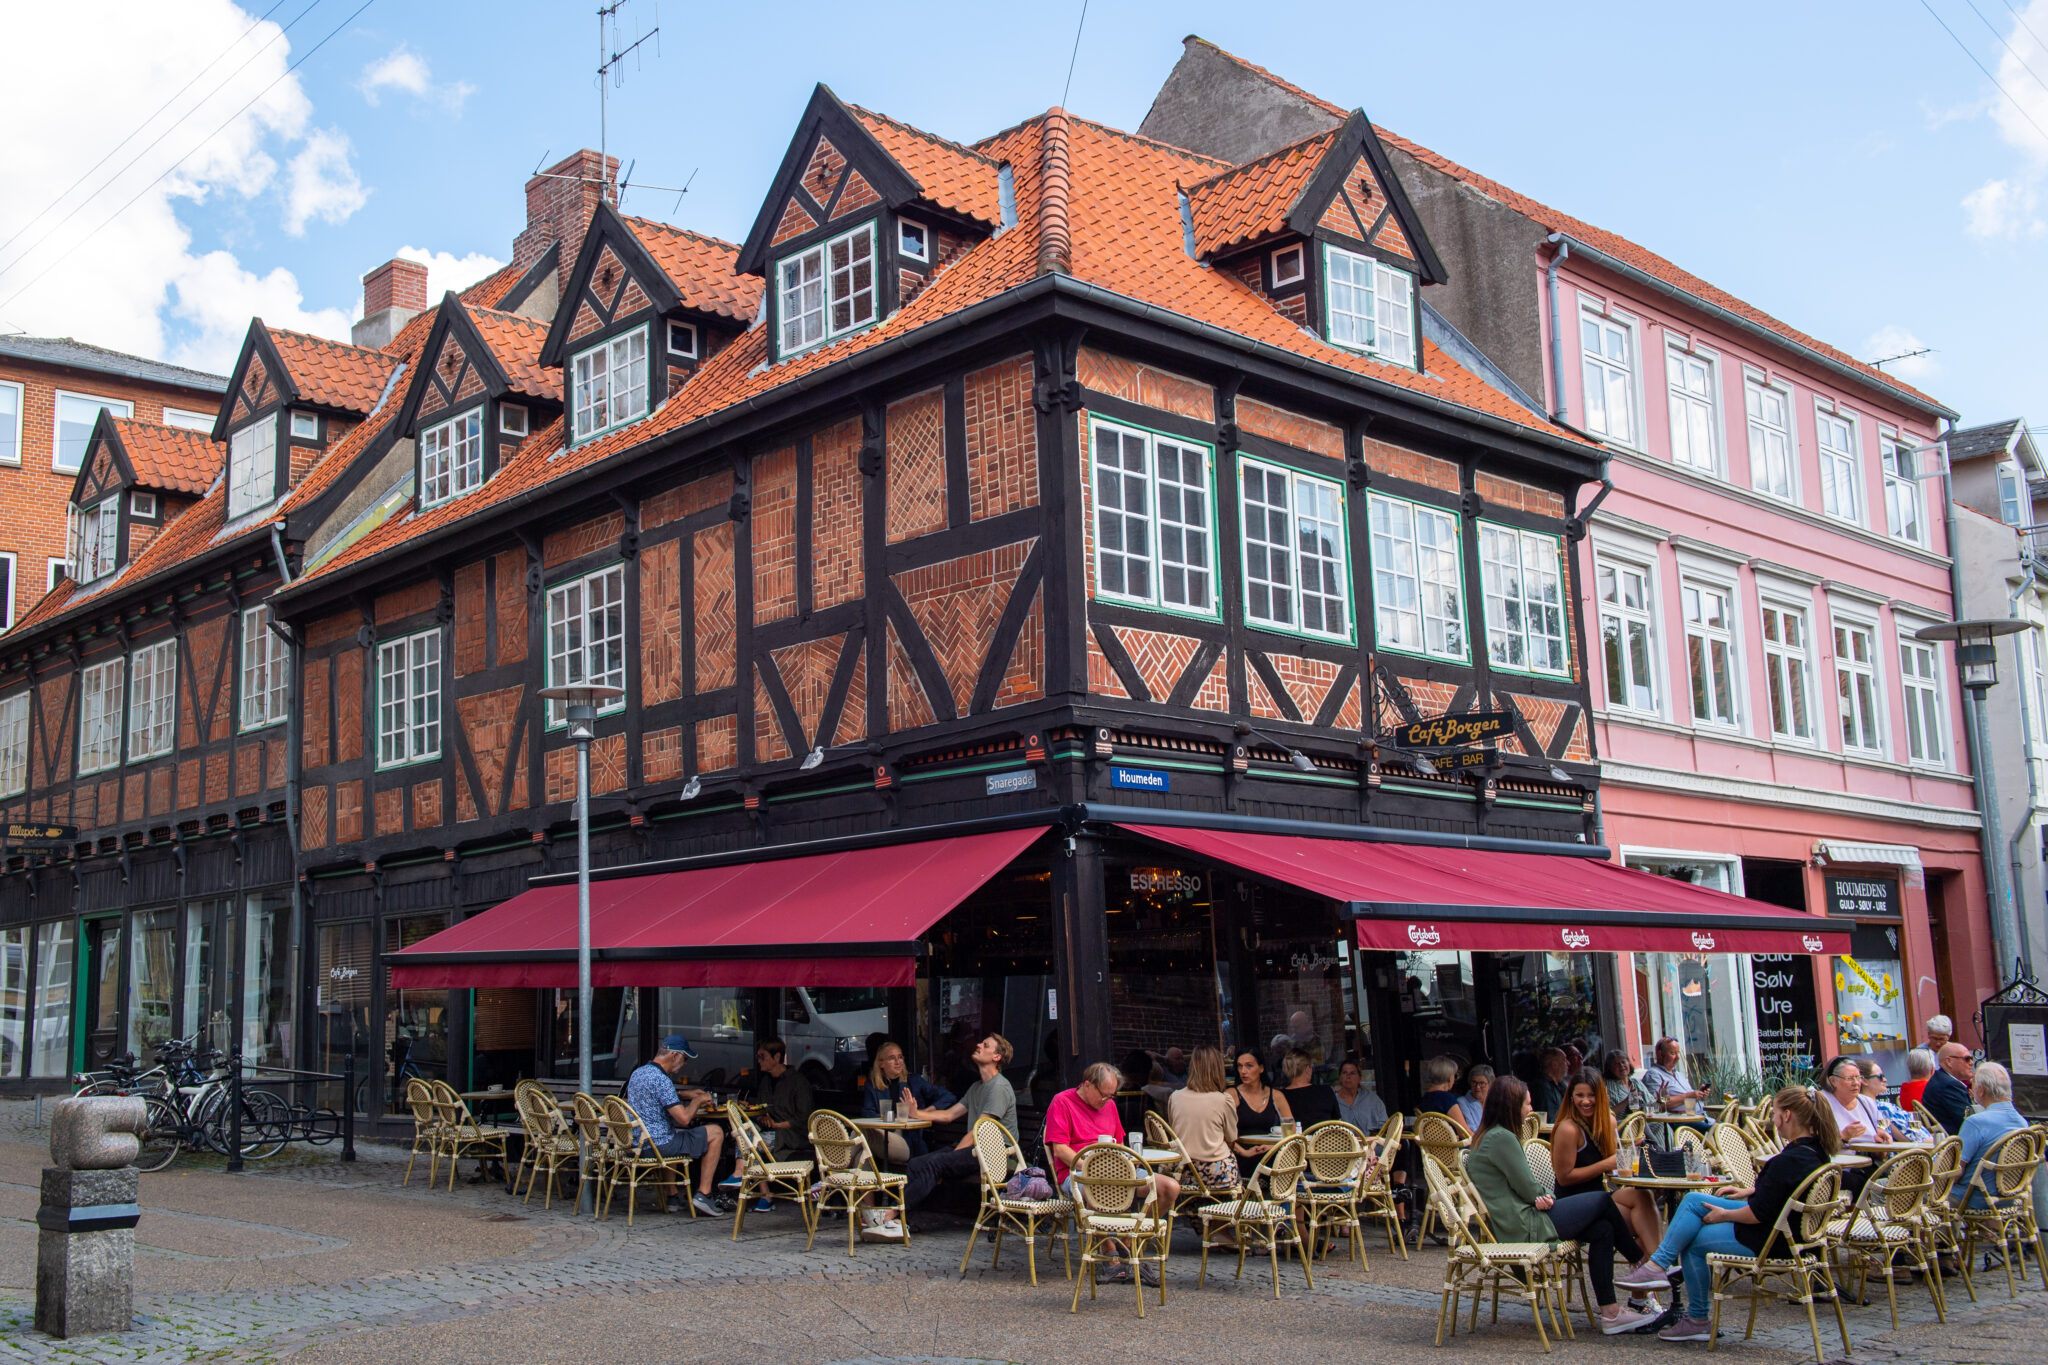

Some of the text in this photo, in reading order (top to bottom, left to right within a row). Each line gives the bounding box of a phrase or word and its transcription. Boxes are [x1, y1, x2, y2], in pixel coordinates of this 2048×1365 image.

[1408, 719, 1500, 746] Café Borgen
[1462, 753, 1484, 766] BAR
[988, 773, 1033, 790] Snaregade
[1119, 769, 1163, 787] Houmeden
[1130, 873, 1202, 892] ESPRESSO
[1835, 881, 1887, 898] HOUMEDENS
[1840, 900, 1855, 910] GULD
[1875, 901, 1887, 912] URE
[1408, 924, 1441, 947] Carlsberg
[1561, 928, 1590, 949] Carlsberg
[1691, 931, 1715, 950] Carlsberg
[1802, 935, 1823, 952] Carlsberg
[1310, 953, 1340, 970] Borgen
[1754, 970, 1793, 988] Sølv
[1761, 997, 1792, 1014] Ure
[1784, 1028, 1803, 1037] Skft
